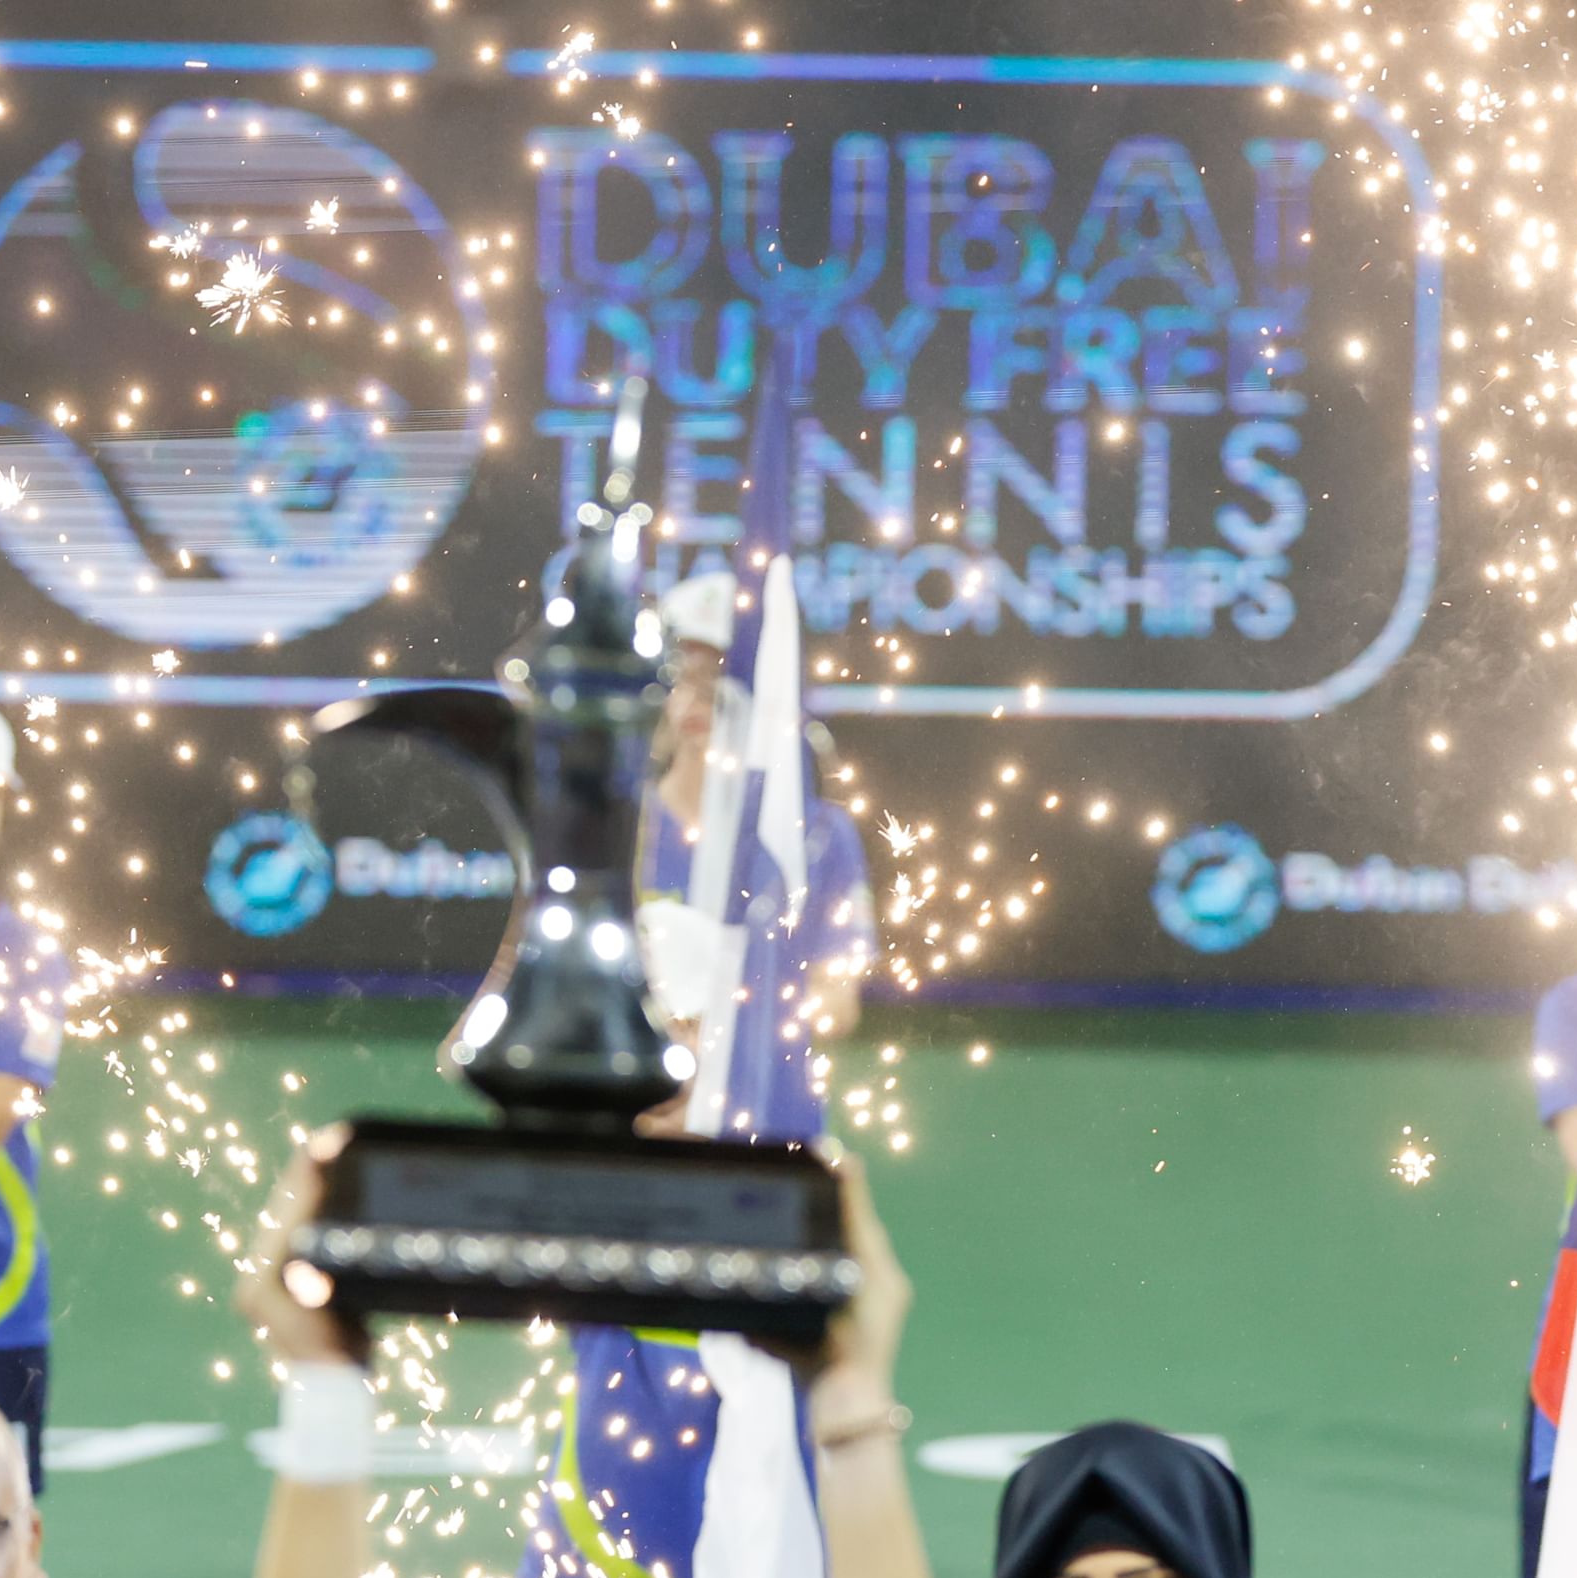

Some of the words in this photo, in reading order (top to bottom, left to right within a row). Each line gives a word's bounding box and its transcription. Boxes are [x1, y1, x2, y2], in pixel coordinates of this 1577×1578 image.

[527, 130, 1328, 316] DUBAI
[544, 299, 938, 412] DUTY
[965, 305, 1310, 418] FREE
[534, 410, 1310, 556] TENNIS
